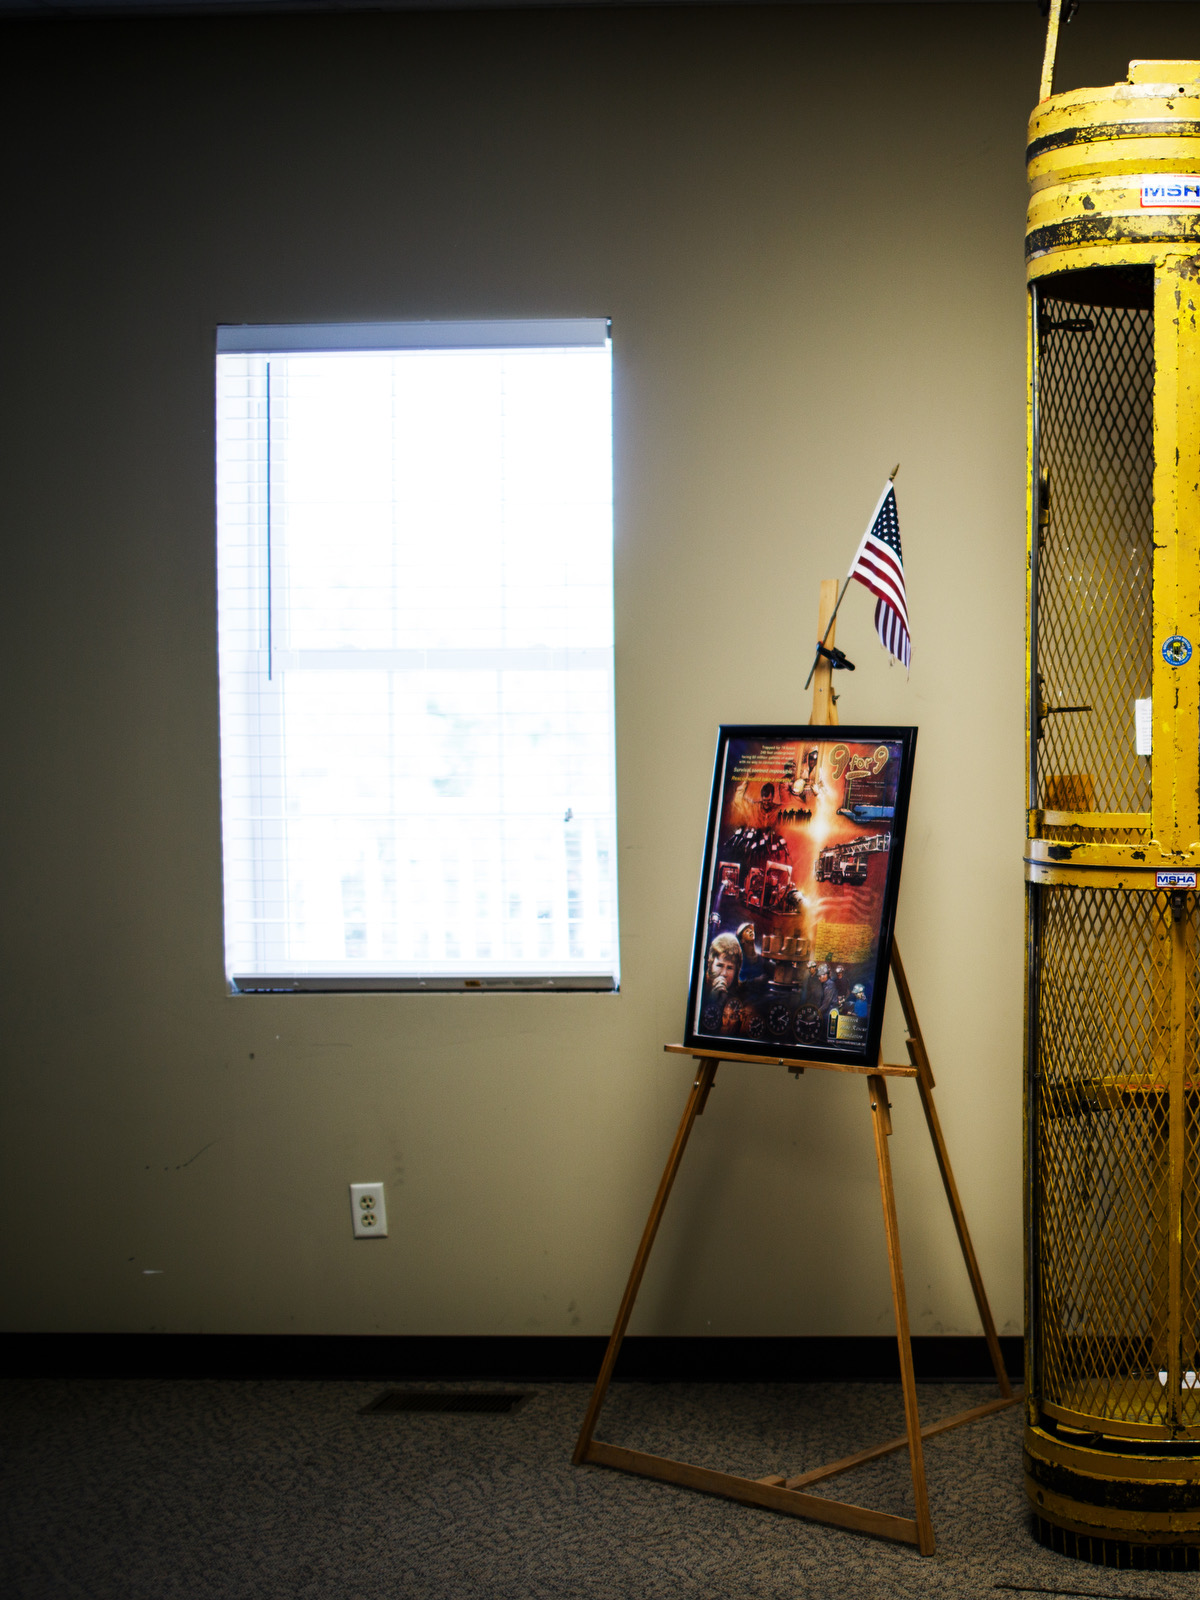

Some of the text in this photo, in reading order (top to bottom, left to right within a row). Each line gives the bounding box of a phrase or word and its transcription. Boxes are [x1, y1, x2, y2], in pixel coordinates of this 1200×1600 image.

[829, 744, 889, 780] 9 for 9
